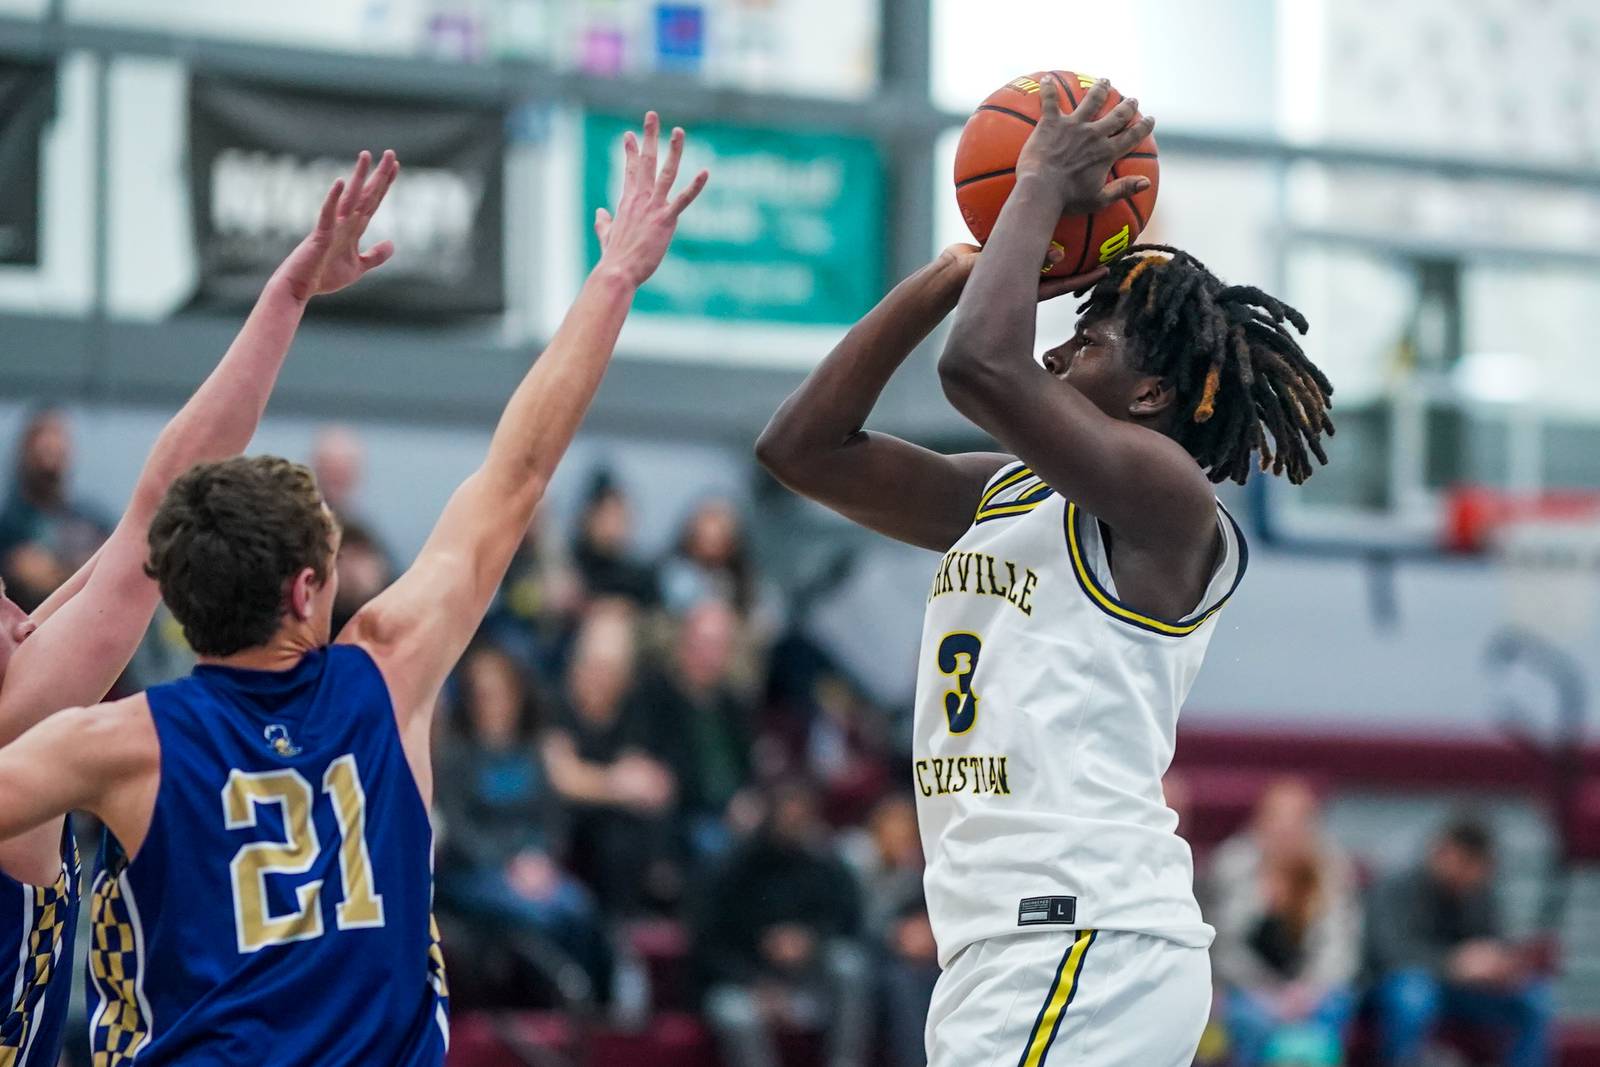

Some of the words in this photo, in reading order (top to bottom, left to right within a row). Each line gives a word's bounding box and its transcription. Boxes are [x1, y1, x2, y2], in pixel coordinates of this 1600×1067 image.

[937, 630, 983, 736] 3
[221, 753, 386, 954] 21
[1057, 903, 1065, 915] L
